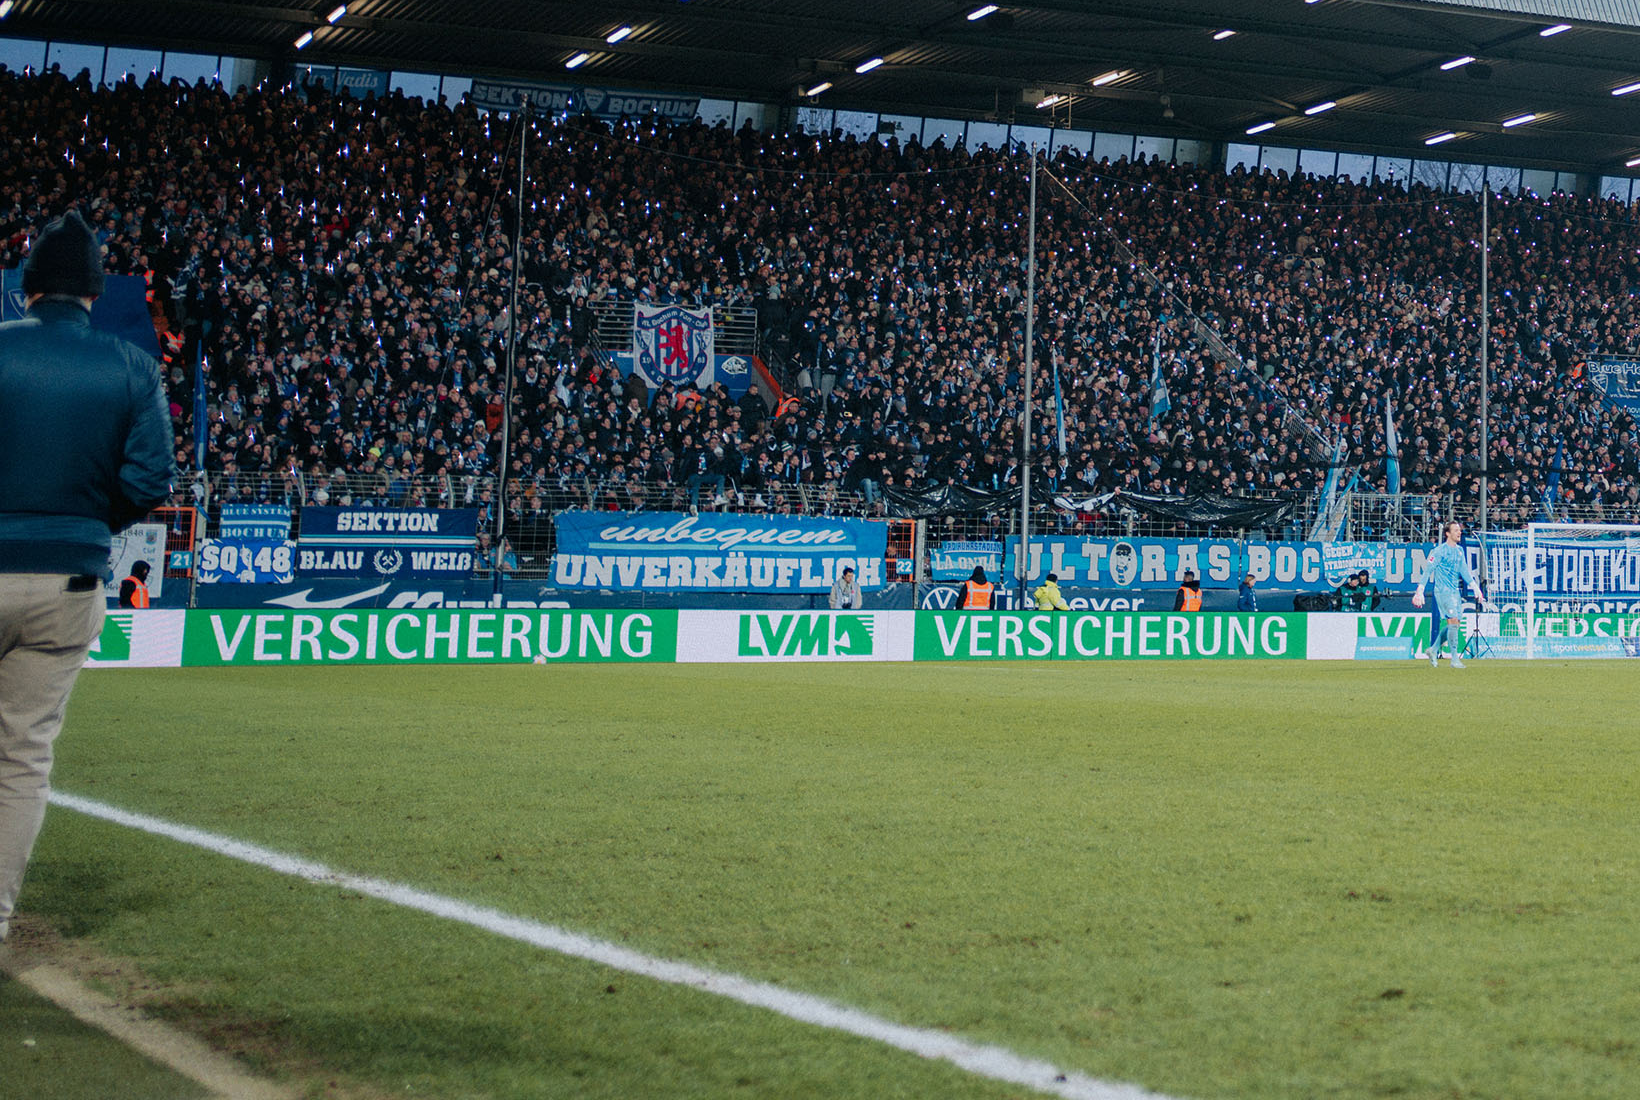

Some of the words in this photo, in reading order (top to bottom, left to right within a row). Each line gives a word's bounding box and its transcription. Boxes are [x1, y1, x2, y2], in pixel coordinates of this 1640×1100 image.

[336, 70, 379, 88] Vadis
[472, 83, 566, 110] SEKTION
[608, 97, 698, 117] BOCHUM
[1587, 361, 1622, 374] Blue
[222, 507, 249, 516] BLUE
[251, 507, 291, 517] SYSTEM
[337, 512, 439, 531] SEKTION
[221, 526, 289, 539] BOCHUM
[599, 517, 847, 551] unbequem
[172, 553, 190, 566] 21
[201, 545, 238, 574] SQ
[254, 546, 292, 573] 48
[300, 551, 363, 570] BLAU
[1325, 545, 1353, 558] GEGEN
[554, 551, 881, 591] UNVERKÄUFLICH
[897, 561, 912, 573] 22
[935, 553, 953, 570] LA
[209, 613, 653, 661] VERSICHERUNG
[737, 614, 830, 656] LVM
[934, 614, 1288, 657] VERSICHERUNG
